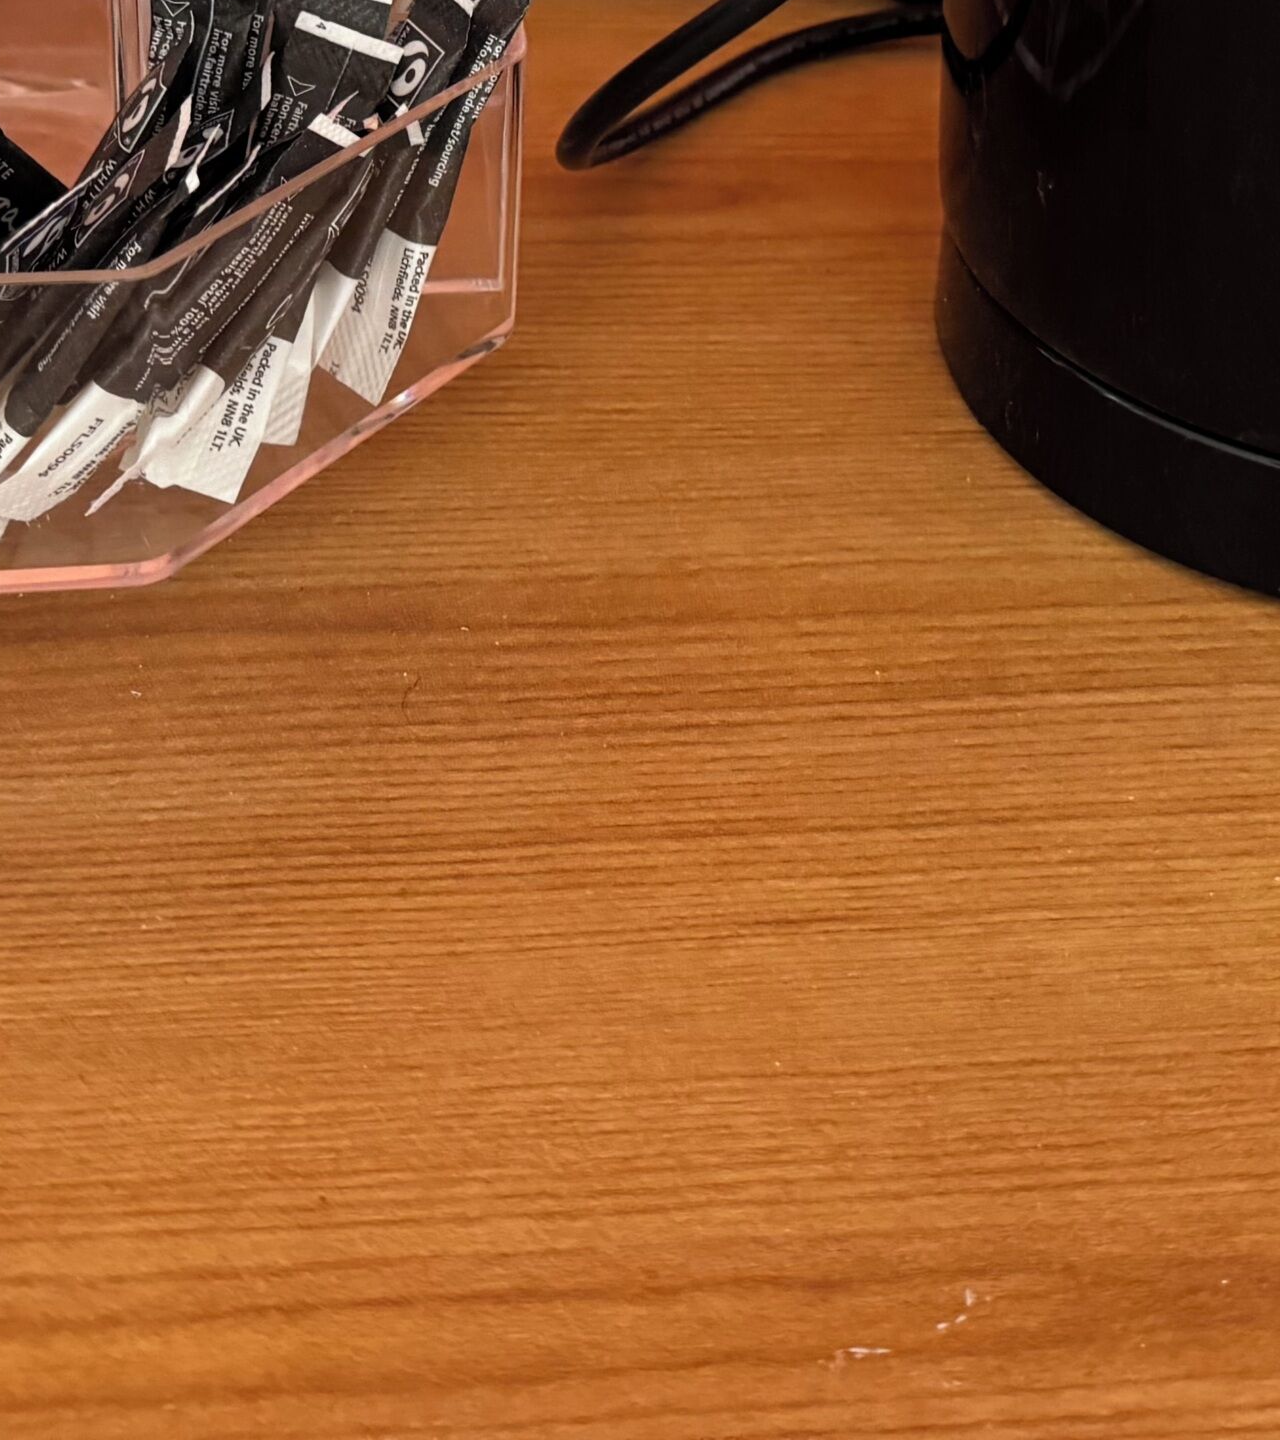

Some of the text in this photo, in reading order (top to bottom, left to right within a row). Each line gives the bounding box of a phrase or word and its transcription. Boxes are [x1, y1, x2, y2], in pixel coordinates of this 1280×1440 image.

[253, 14, 264, 34] For
[247, 38, 262, 69] more
[207, 32, 232, 115] For more visit
[127, 241, 142, 263] For
[219, 244, 249, 279] basis,
[408, 251, 430, 294] Packed
[405, 294, 417, 307] in
[398, 308, 413, 330] the
[377, 330, 392, 355] 1LT.
[227, 342, 279, 450] Packed in the UK.
[219, 397, 240, 427] NN8
[208, 428, 228, 454] 1LT.
